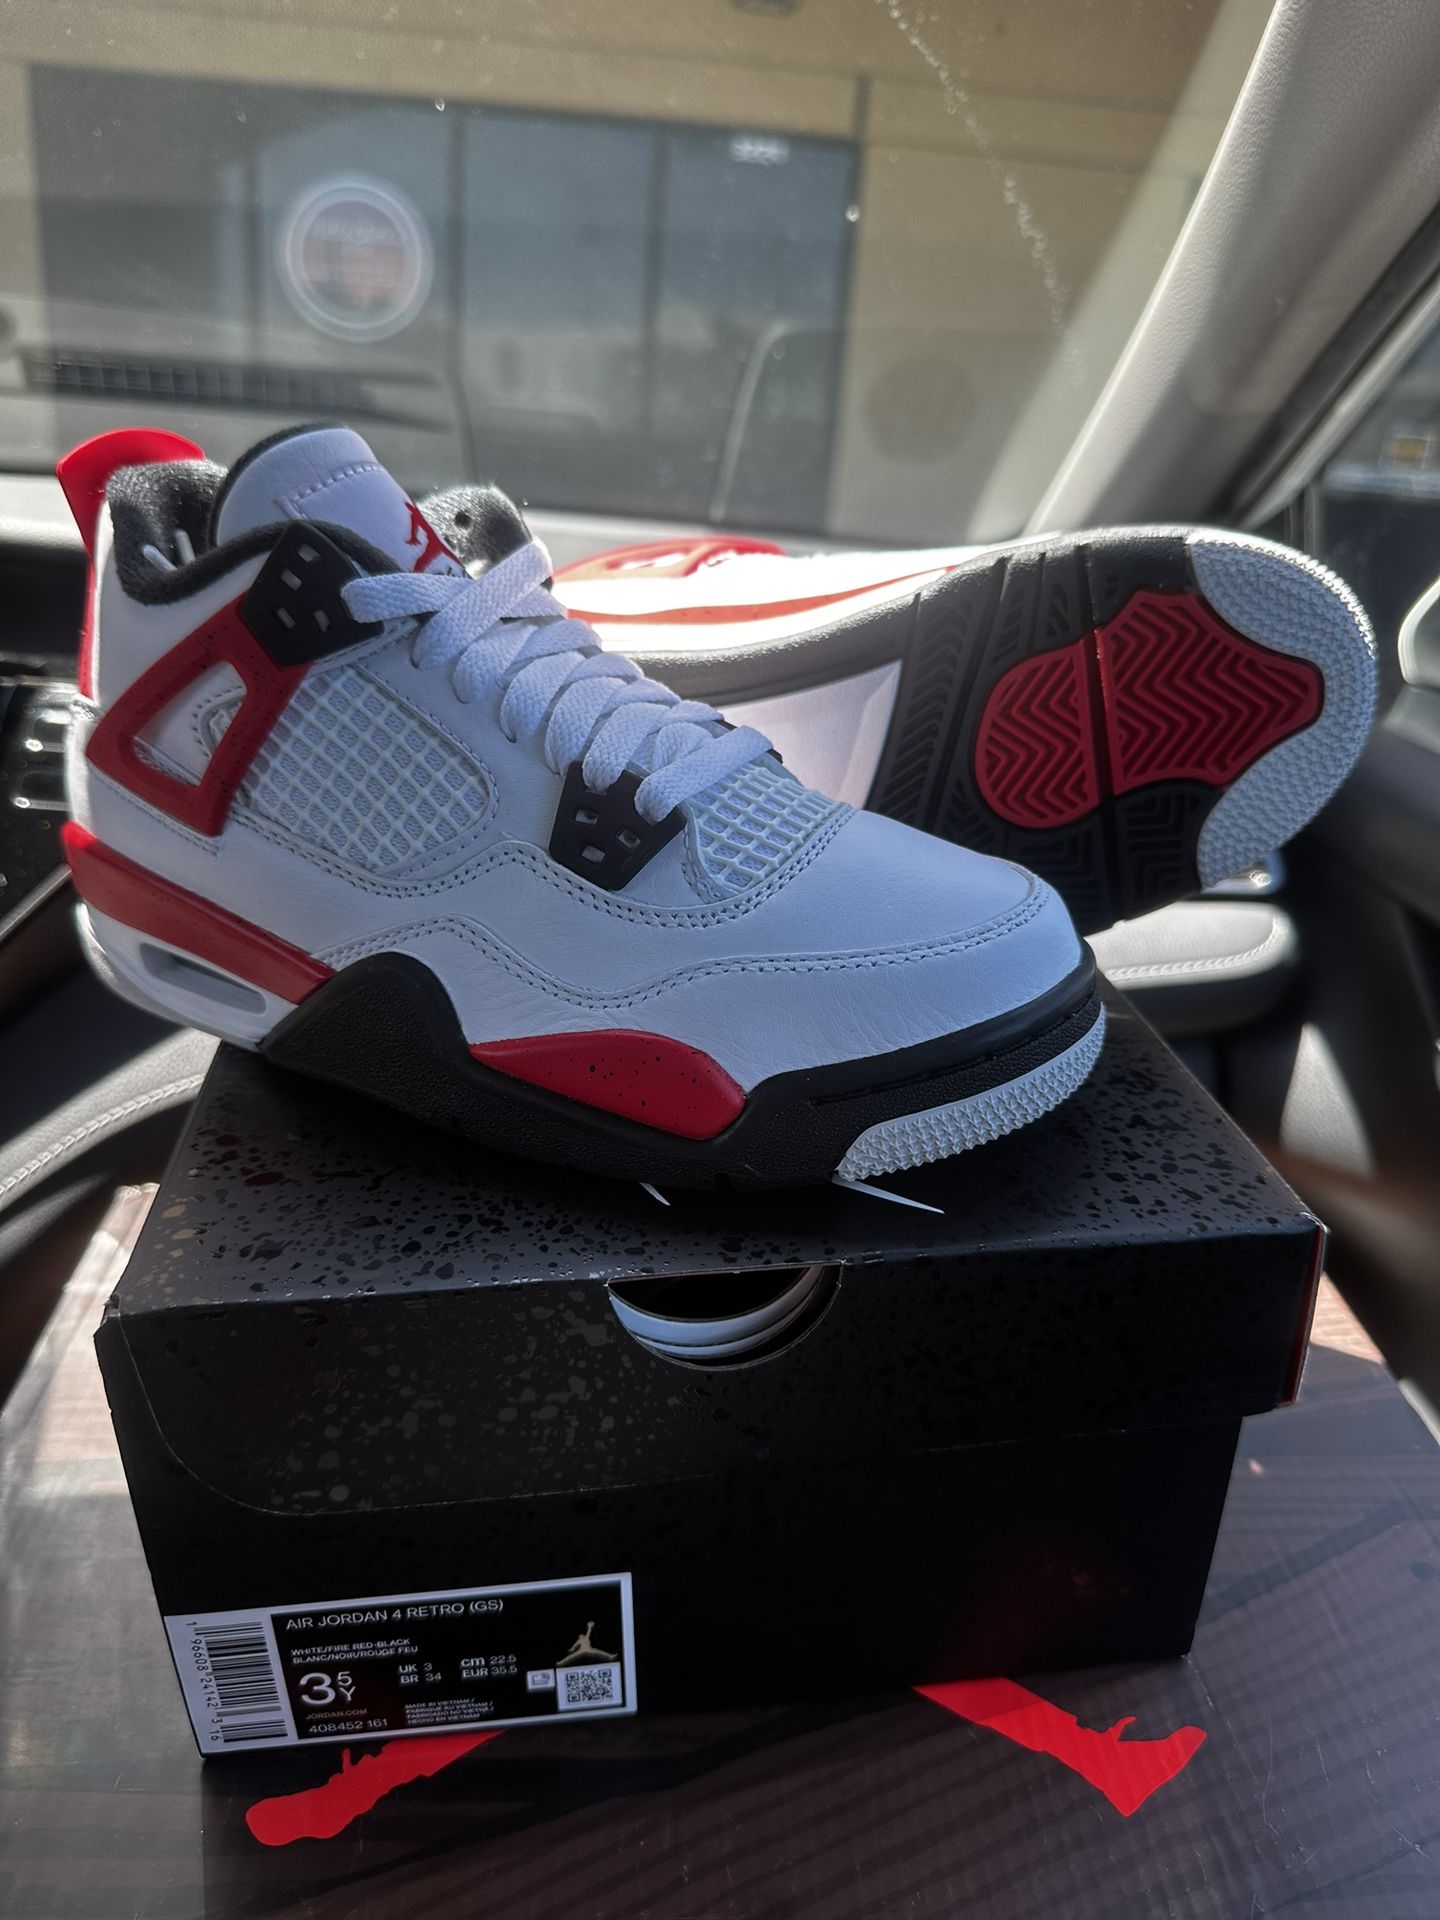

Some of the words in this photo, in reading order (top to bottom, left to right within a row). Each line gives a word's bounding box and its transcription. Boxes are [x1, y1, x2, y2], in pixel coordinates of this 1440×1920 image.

[287, 1617, 314, 1630] AIR
[318, 1610, 388, 1627] JORDAN
[391, 1608, 402, 1619] 4
[406, 1603, 464, 1619] RETRO
[470, 1598, 504, 1613] (GS)
[190, 1638, 209, 1671] 96608
[291, 1643, 351, 1657] WHITE/FIRE
[352, 1638, 411, 1651] RED-BLACK
[293, 1647, 396, 1664] BLANC/NOIR/ROUGE
[397, 1645, 419, 1654] FEU
[399, 1663, 418, 1673] UK
[423, 1662, 433, 1671] 3
[461, 1657, 486, 1667] cm
[490, 1654, 517, 1665] 22.5
[400, 1674, 420, 1684] BR
[424, 1672, 442, 1682] 34
[462, 1667, 489, 1678] EUR
[490, 1664, 518, 1675] 35.5
[200, 1677, 219, 1708] 24142
[299, 1671, 336, 1705] 3
[339, 1685, 357, 1702] Y
[304, 1708, 368, 1721] JORDAN.COM
[308, 1720, 364, 1733] 408452
[366, 1718, 388, 1728] 161
